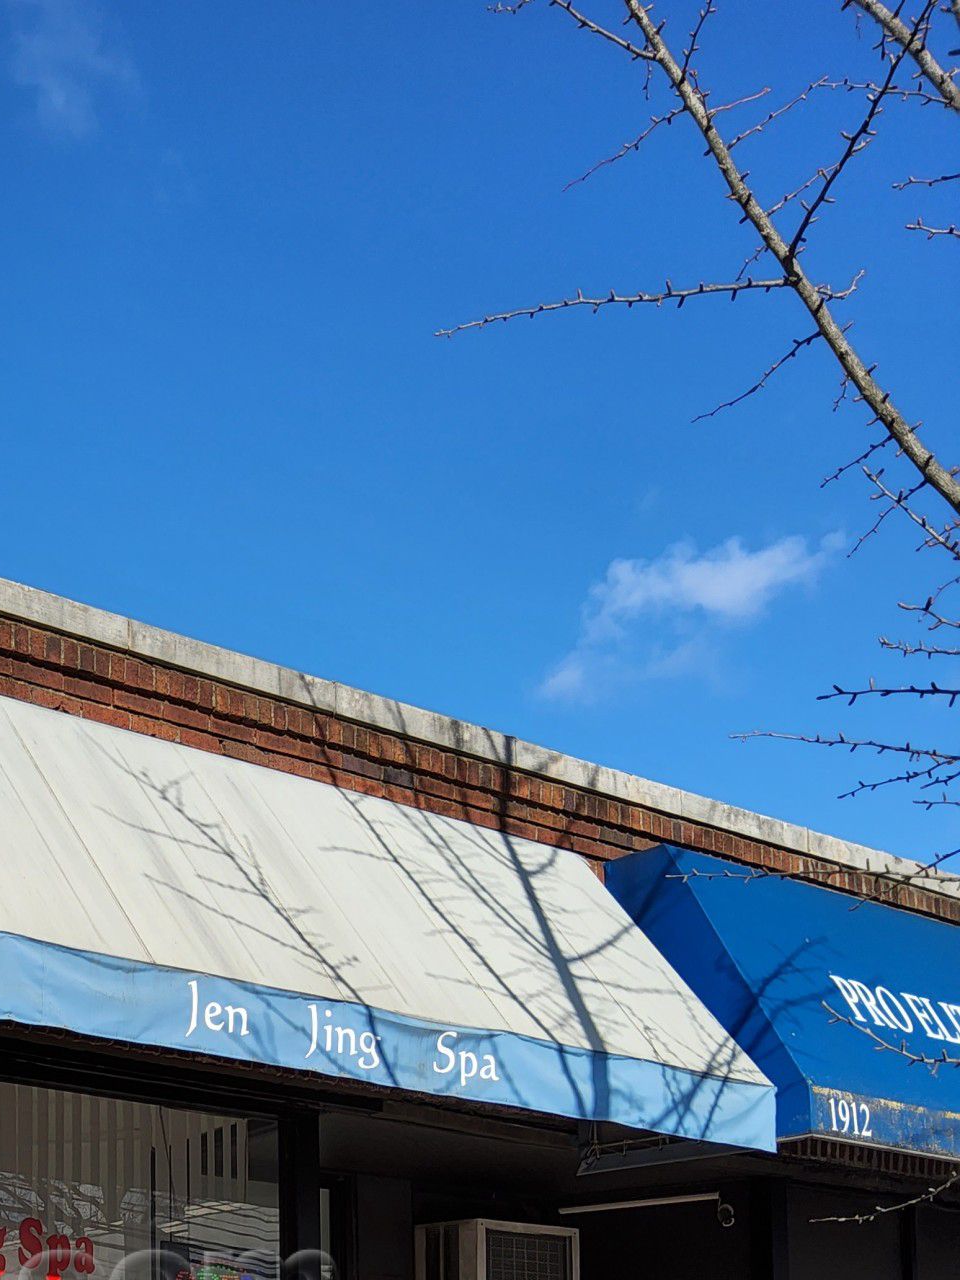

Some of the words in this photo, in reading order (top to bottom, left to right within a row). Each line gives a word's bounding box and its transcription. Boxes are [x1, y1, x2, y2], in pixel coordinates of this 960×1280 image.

[185, 980, 249, 1037] Jen
[305, 1004, 381, 1069] Jing
[433, 1031, 499, 1086] Spa
[829, 974, 914, 1034] PRO
[828, 1097, 873, 1137] 1912
